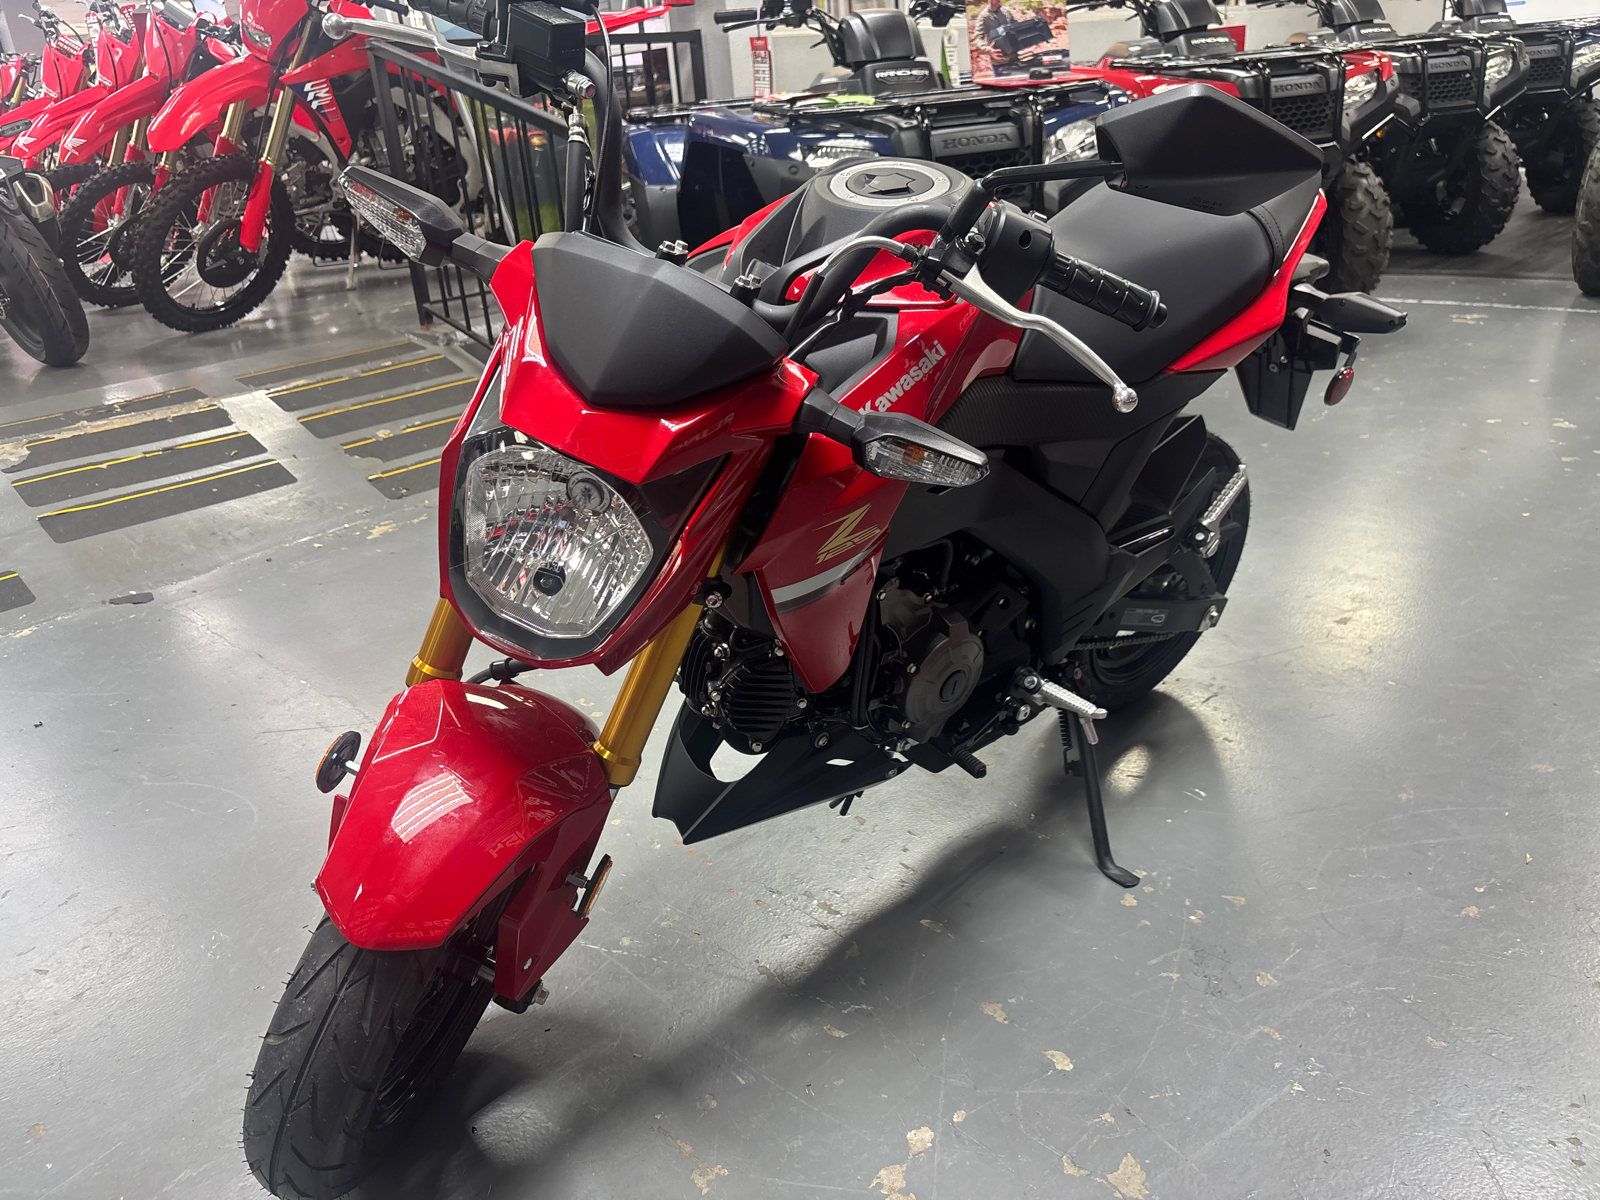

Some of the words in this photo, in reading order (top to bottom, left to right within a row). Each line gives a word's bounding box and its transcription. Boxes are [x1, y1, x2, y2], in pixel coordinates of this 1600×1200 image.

[1430, 60, 1469, 70] HONDA
[875, 68, 930, 79] RANCHER
[304, 78, 333, 110] CRF
[1273, 81, 1322, 94] HONDA
[941, 132, 1013, 150] HONDA
